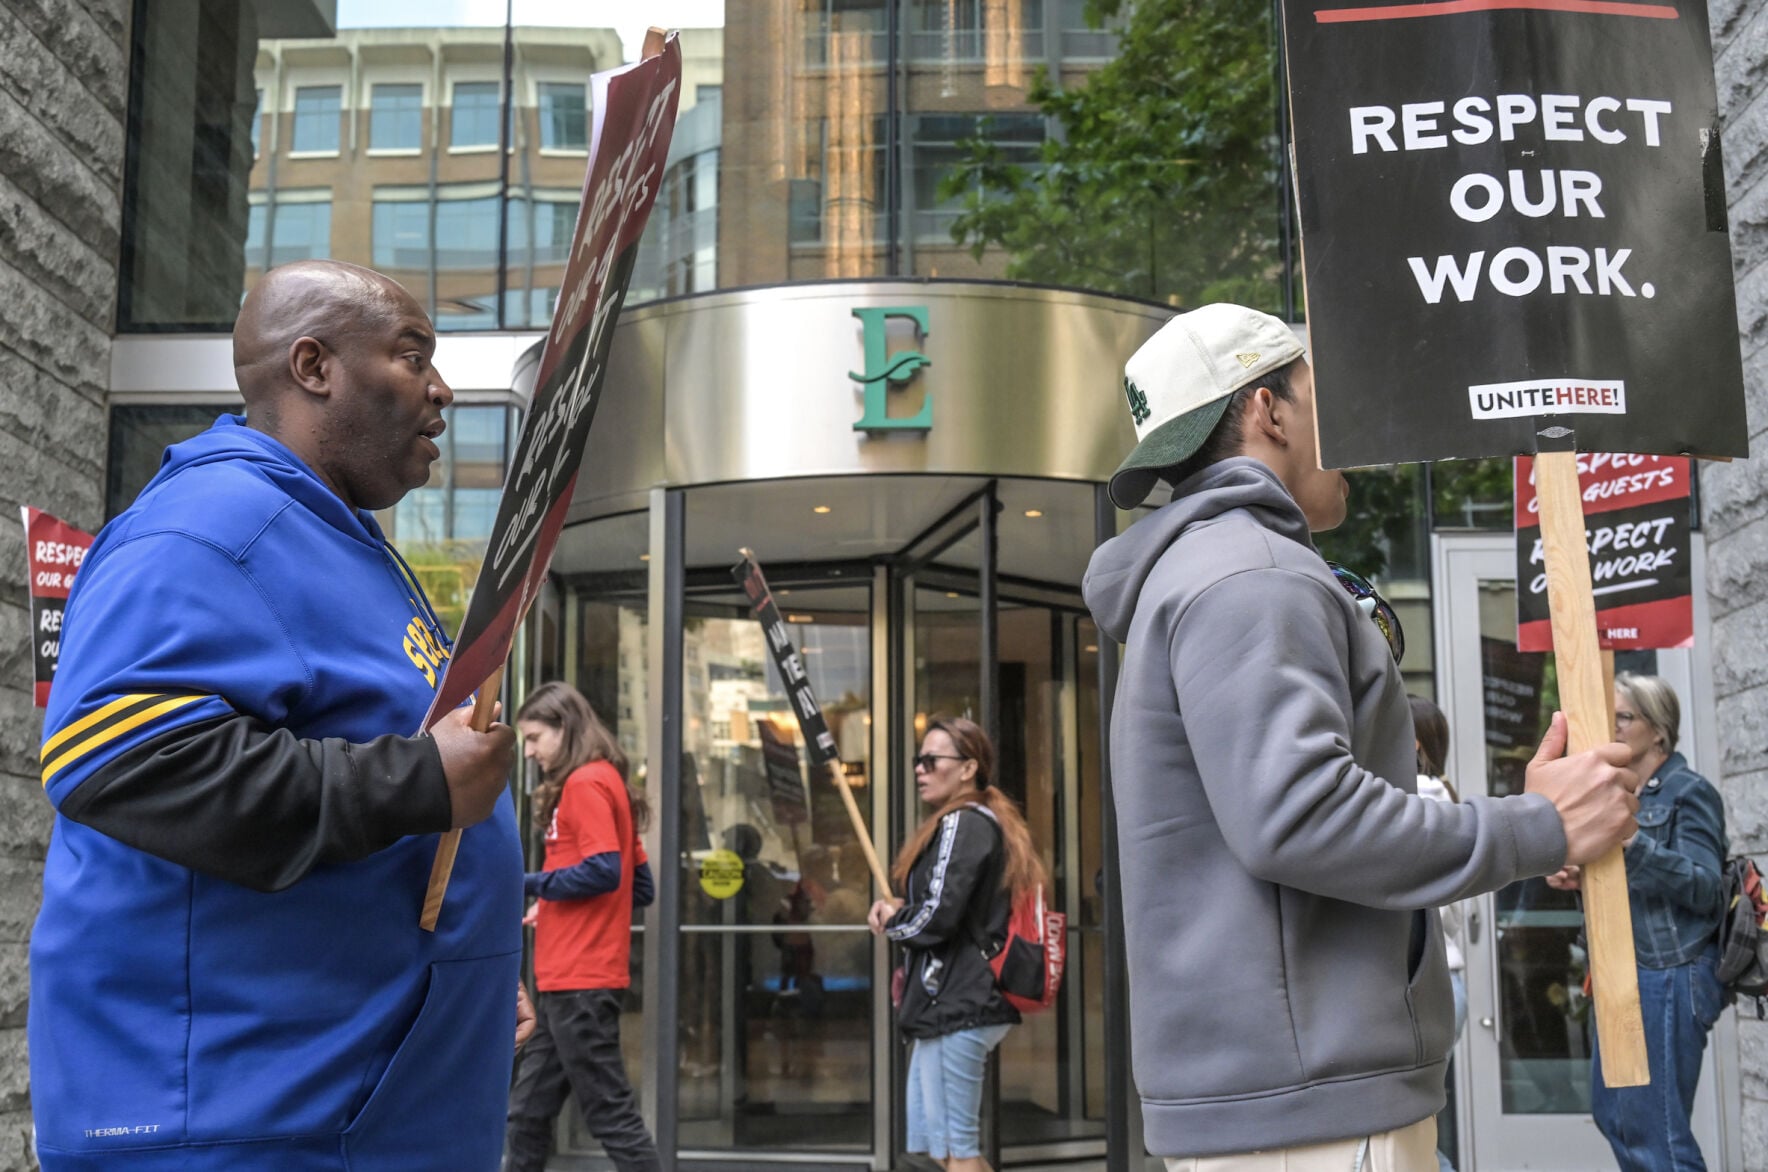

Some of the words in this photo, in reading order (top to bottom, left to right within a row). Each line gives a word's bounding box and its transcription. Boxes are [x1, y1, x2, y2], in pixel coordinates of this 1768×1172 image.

[1349, 94, 1672, 155] RESPECT
[1449, 169, 1606, 223] OUR
[1407, 246, 1656, 304] WORK.
[1477, 386, 1619, 413] UNITEHERE!
[1582, 466, 1675, 503] GUESTS
[35, 540, 89, 567] RESPE
[1593, 547, 1678, 582] WORK
[36, 571, 62, 588] OUR
